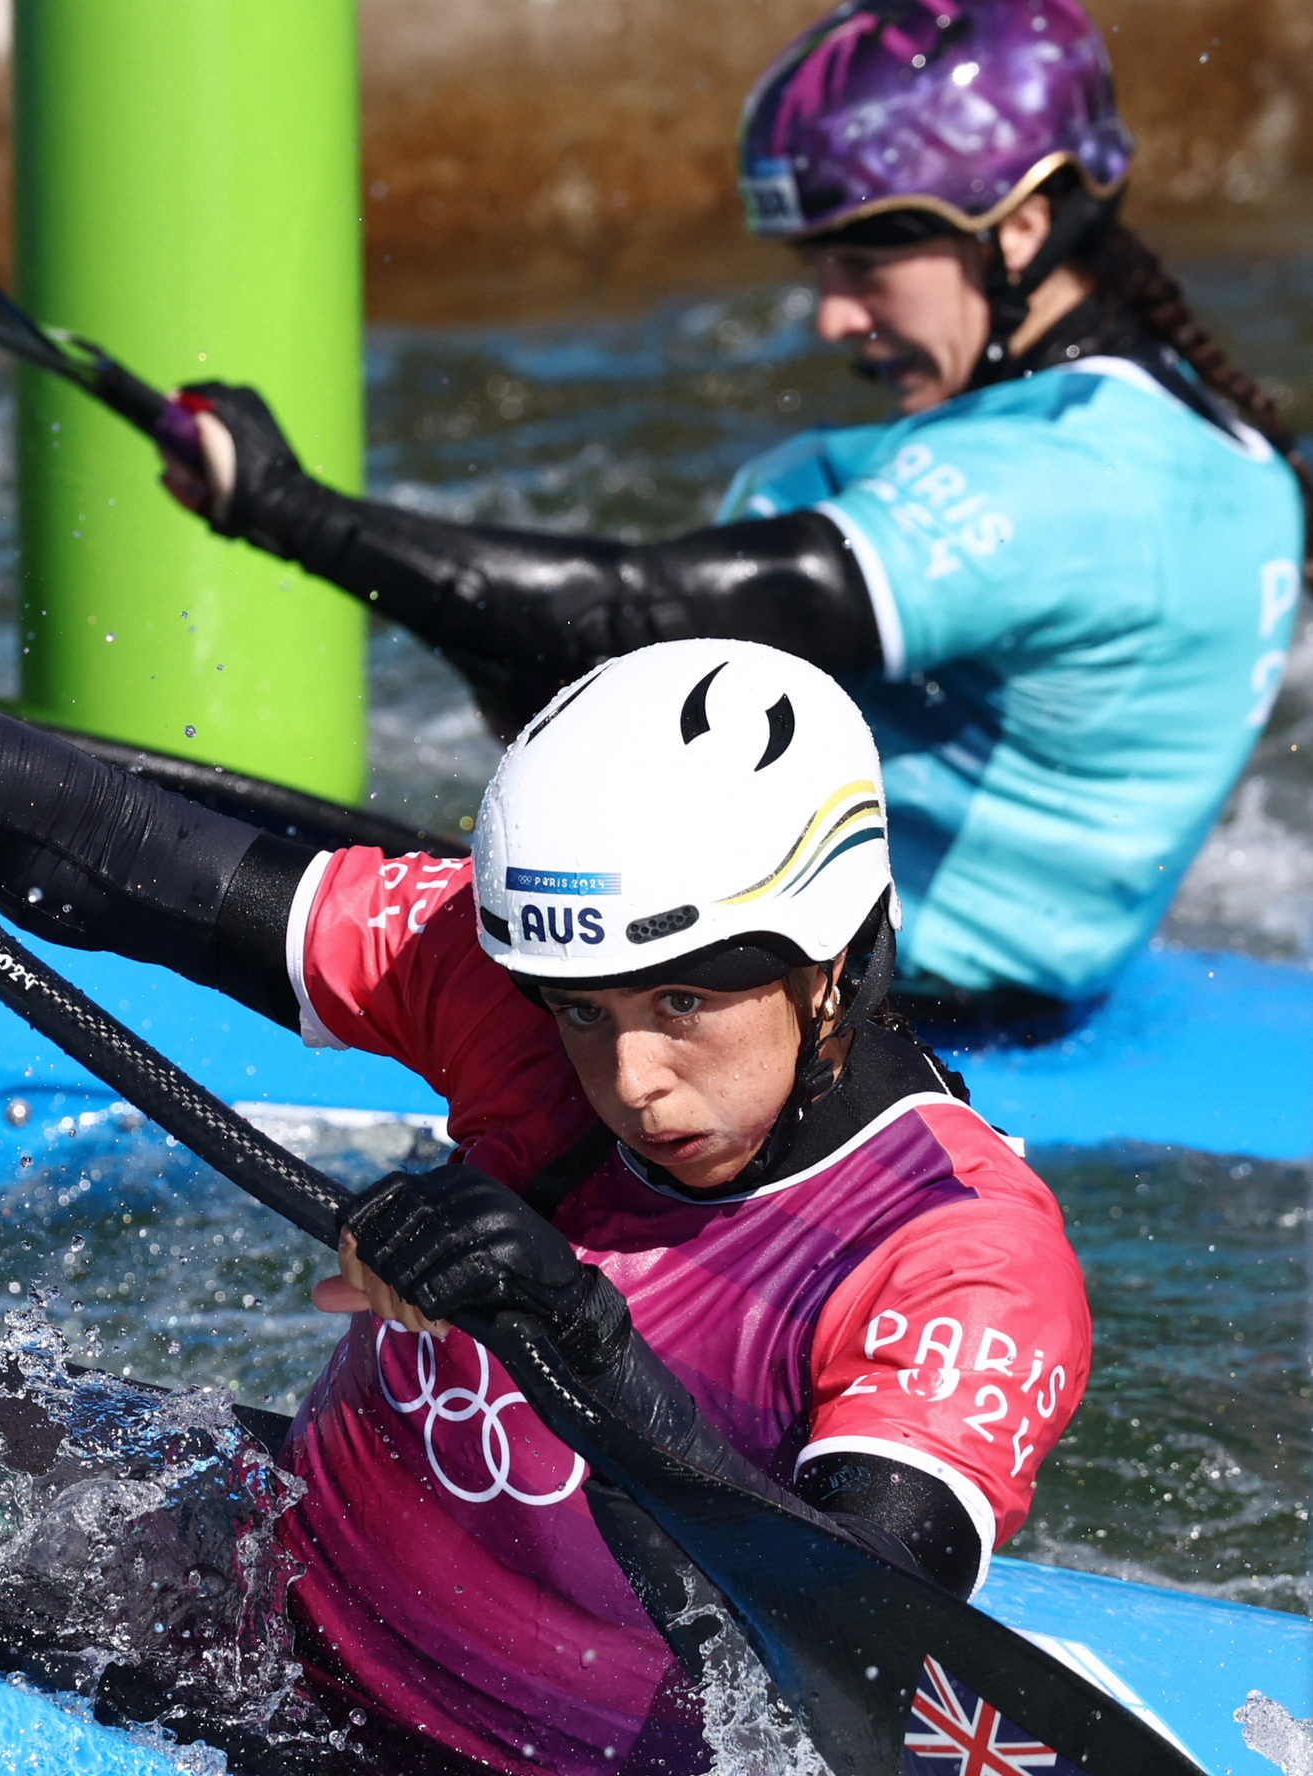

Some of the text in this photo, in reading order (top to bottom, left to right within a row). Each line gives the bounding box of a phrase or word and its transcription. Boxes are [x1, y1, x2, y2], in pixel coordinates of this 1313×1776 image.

[534, 876, 605, 889] PARIS 2024
[521, 903, 605, 945] AUS
